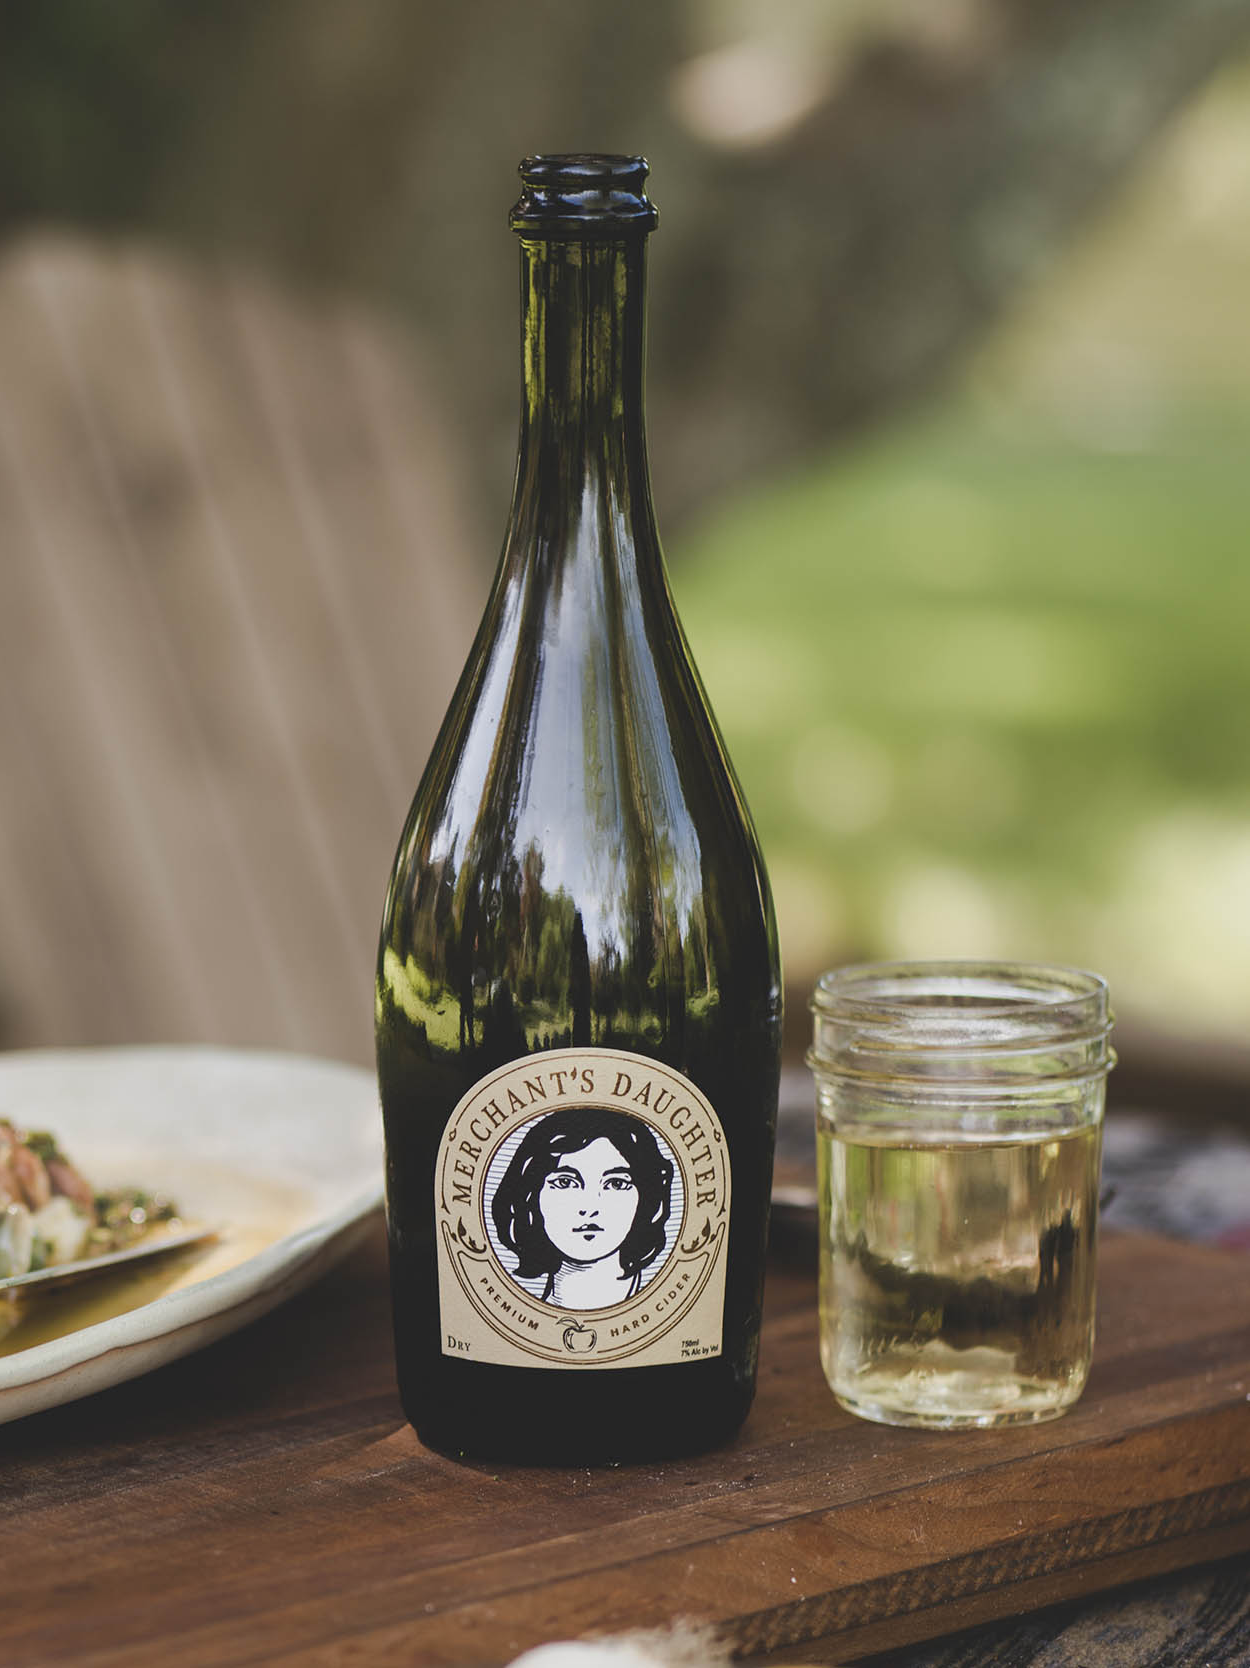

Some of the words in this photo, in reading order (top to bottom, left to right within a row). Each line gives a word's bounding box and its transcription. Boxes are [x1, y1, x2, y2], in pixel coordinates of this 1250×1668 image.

[452, 1067, 595, 1206] MERCHANT'S
[613, 1072, 717, 1208] DAUGHTER
[480, 1277, 540, 1331] PREMIUM
[610, 1314, 650, 1337] HARD
[655, 1273, 691, 1312] CIDER
